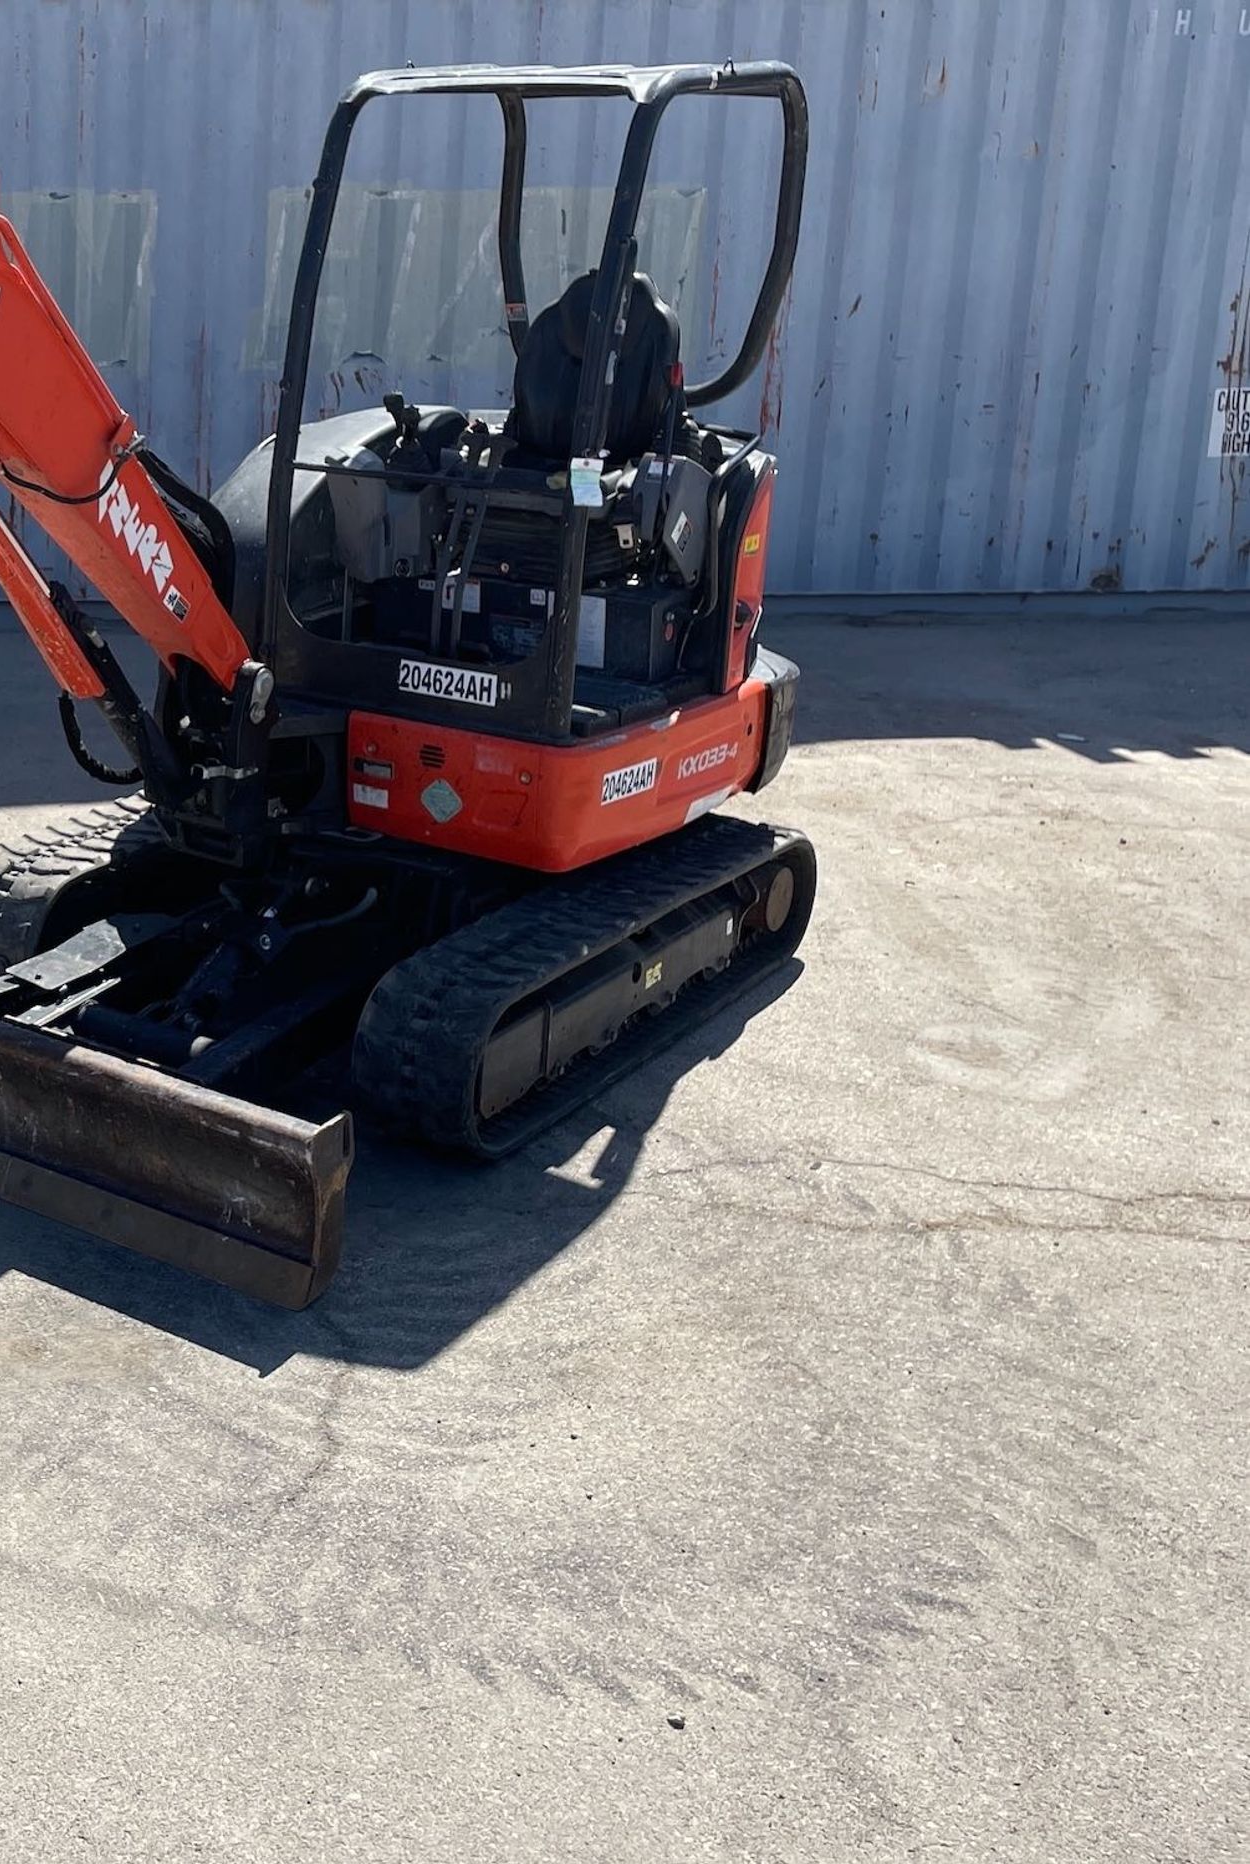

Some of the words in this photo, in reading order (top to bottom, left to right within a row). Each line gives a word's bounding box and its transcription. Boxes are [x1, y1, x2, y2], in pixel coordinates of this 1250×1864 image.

[400, 663, 493, 703] 204624AH
[602, 761, 654, 802] 204624AH
[678, 742, 739, 781] KX033-4
